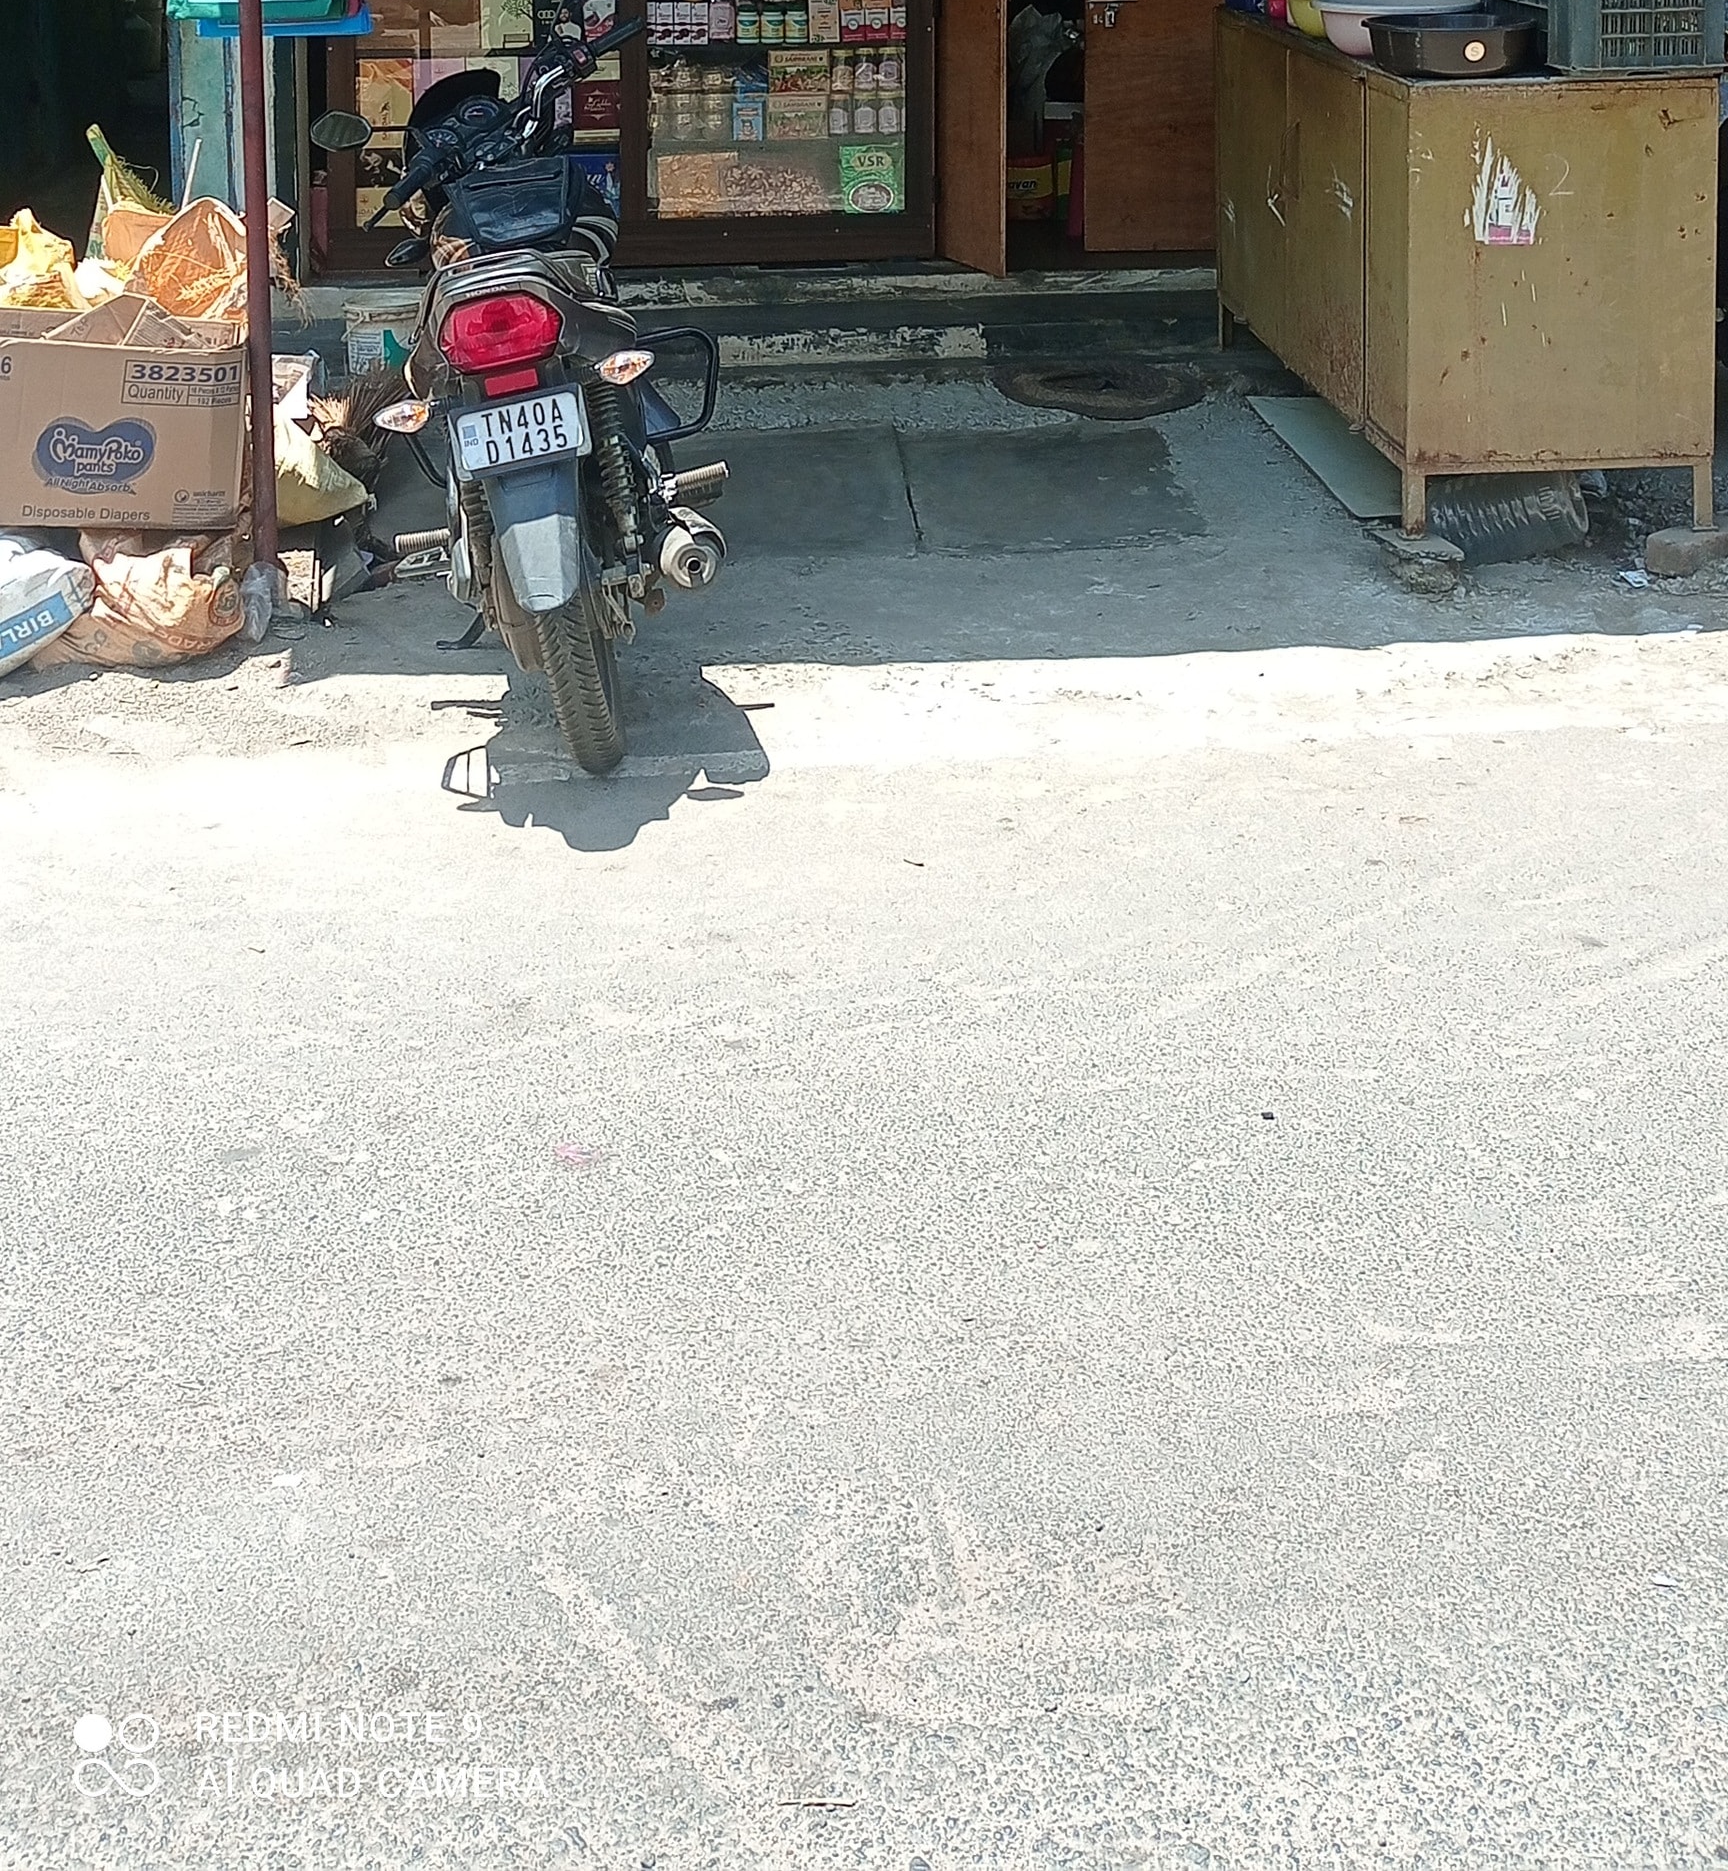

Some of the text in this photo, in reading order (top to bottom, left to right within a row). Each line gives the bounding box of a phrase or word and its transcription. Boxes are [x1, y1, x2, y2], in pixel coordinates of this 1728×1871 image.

[857, 155, 884, 167] VSR
[465, 285, 508, 298] HONDA
[131, 363, 238, 382] 3823501
[128, 383, 184, 403] Quantity
[481, 397, 563, 439] TN40A
[51, 429, 144, 464] MamyPoko
[464, 437, 479, 447] IND
[485, 424, 568, 465] D1435
[75, 461, 116, 476] pants
[22, 505, 151, 522] Disposable Diapers
[0, 609, 54, 650] BIRL
